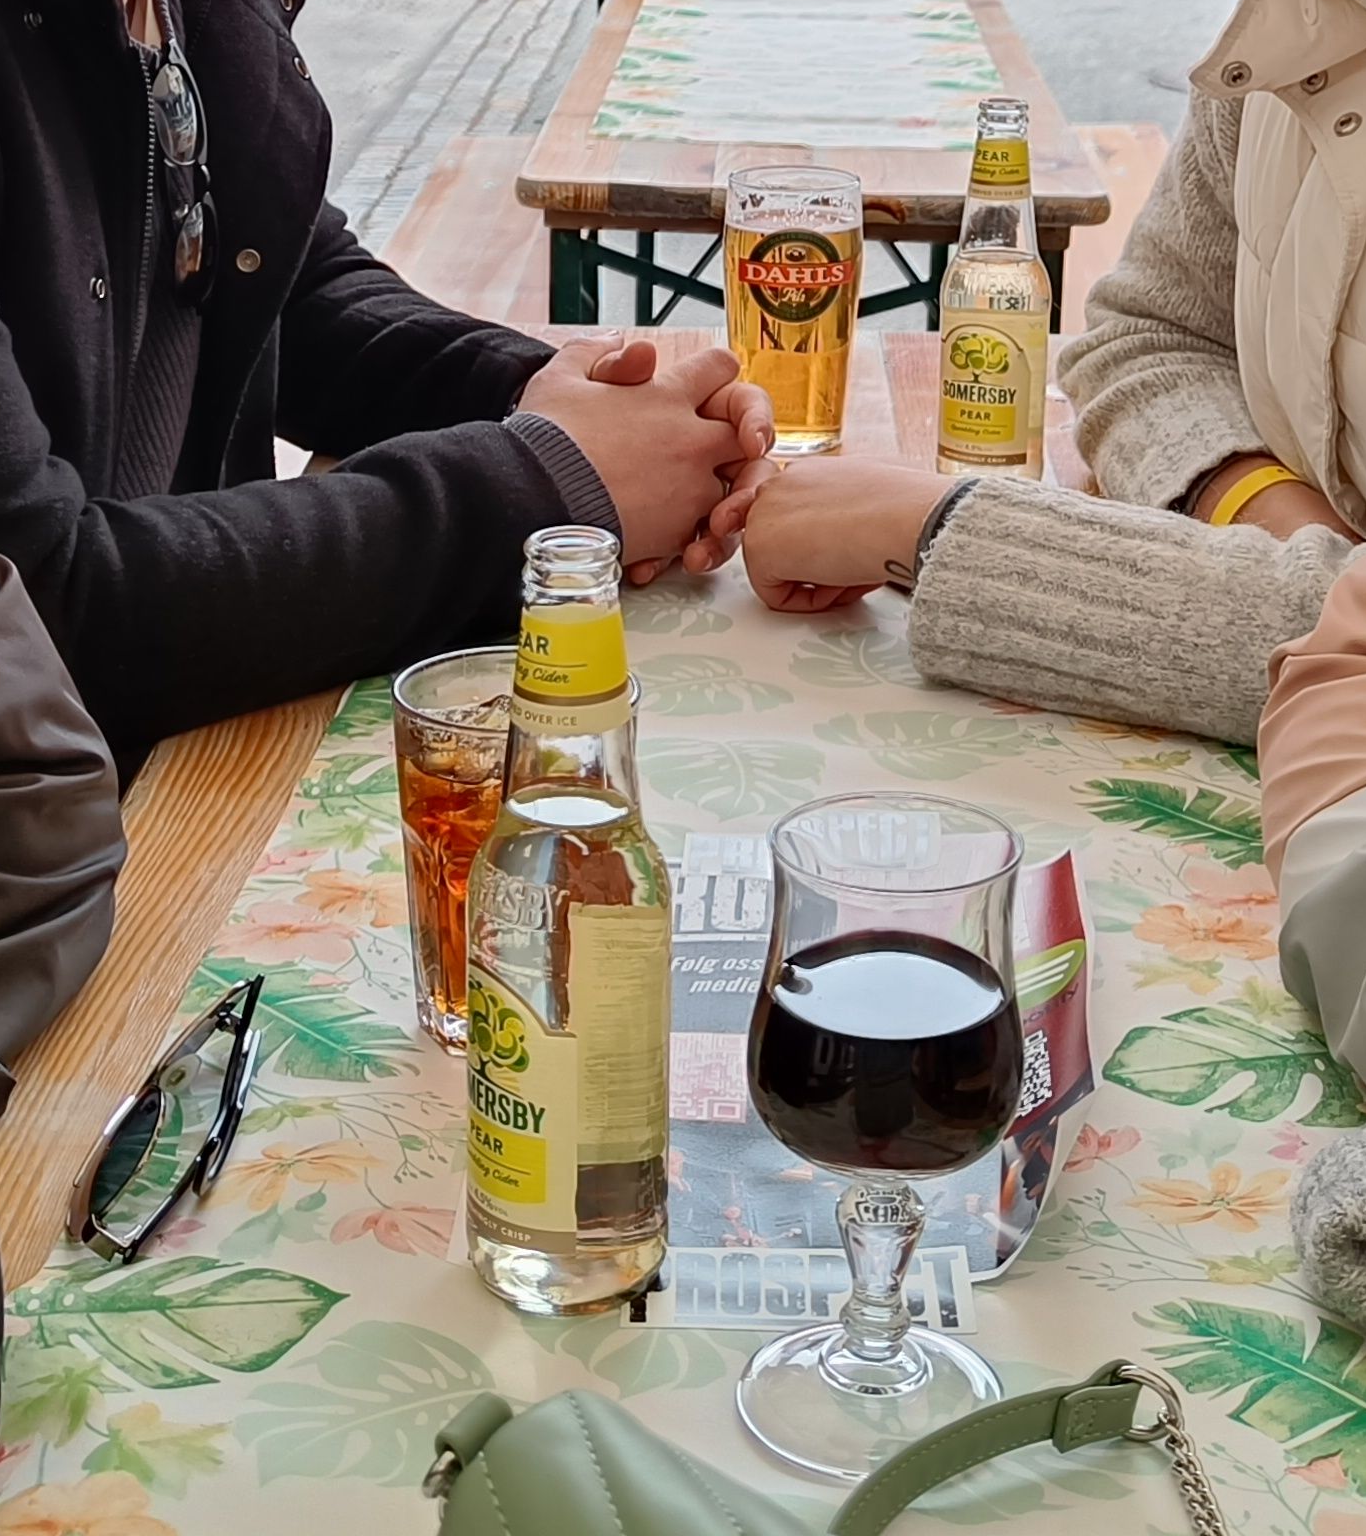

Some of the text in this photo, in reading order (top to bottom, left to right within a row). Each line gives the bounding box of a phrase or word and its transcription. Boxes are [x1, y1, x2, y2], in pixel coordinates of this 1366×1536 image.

[975, 149, 1010, 162] PEAR
[745, 264, 845, 284] DAHLS
[782, 287, 807, 303] Pils
[942, 380, 1017, 405] SOMERSBY
[960, 409, 992, 422] PEAR
[517, 627, 550, 656] EAR
[532, 668, 571, 684] Cider
[524, 710, 554, 725] OVER
[557, 716, 578, 726] ICE
[468, 1068, 546, 1134] MERSBY
[470, 1119, 504, 1156] PEAR
[492, 1168, 520, 1188] Cider
[501, 1226, 532, 1243] CRISP
